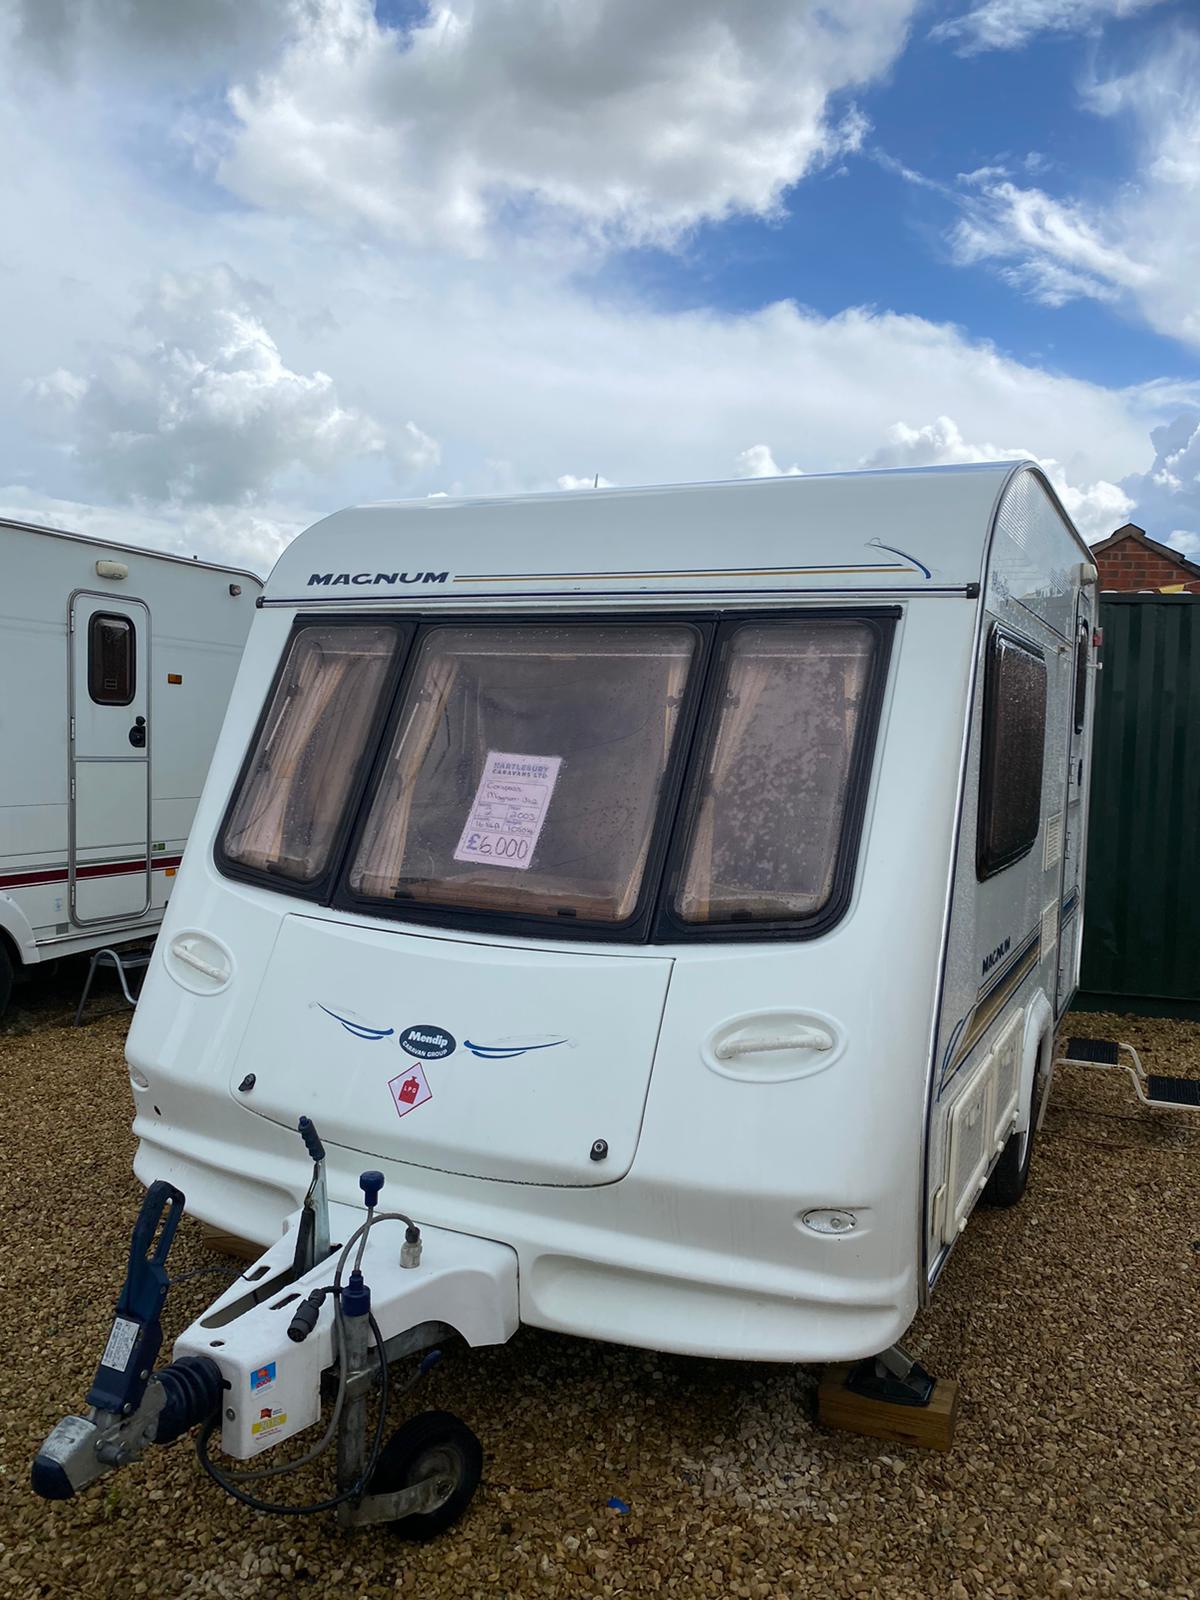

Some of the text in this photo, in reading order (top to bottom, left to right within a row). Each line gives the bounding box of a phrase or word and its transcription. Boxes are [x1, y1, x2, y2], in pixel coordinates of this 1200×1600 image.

[307, 572, 450, 586] MAGNUM
[492, 769, 531, 777] CARAVANS
[466, 834, 528, 859] £6,000
[982, 936, 1010, 976] MAGNUM
[408, 1031, 448, 1048] Mendip
[402, 1041, 448, 1057] CARAVAN GROUP
[404, 1085, 417, 1094] LPG
